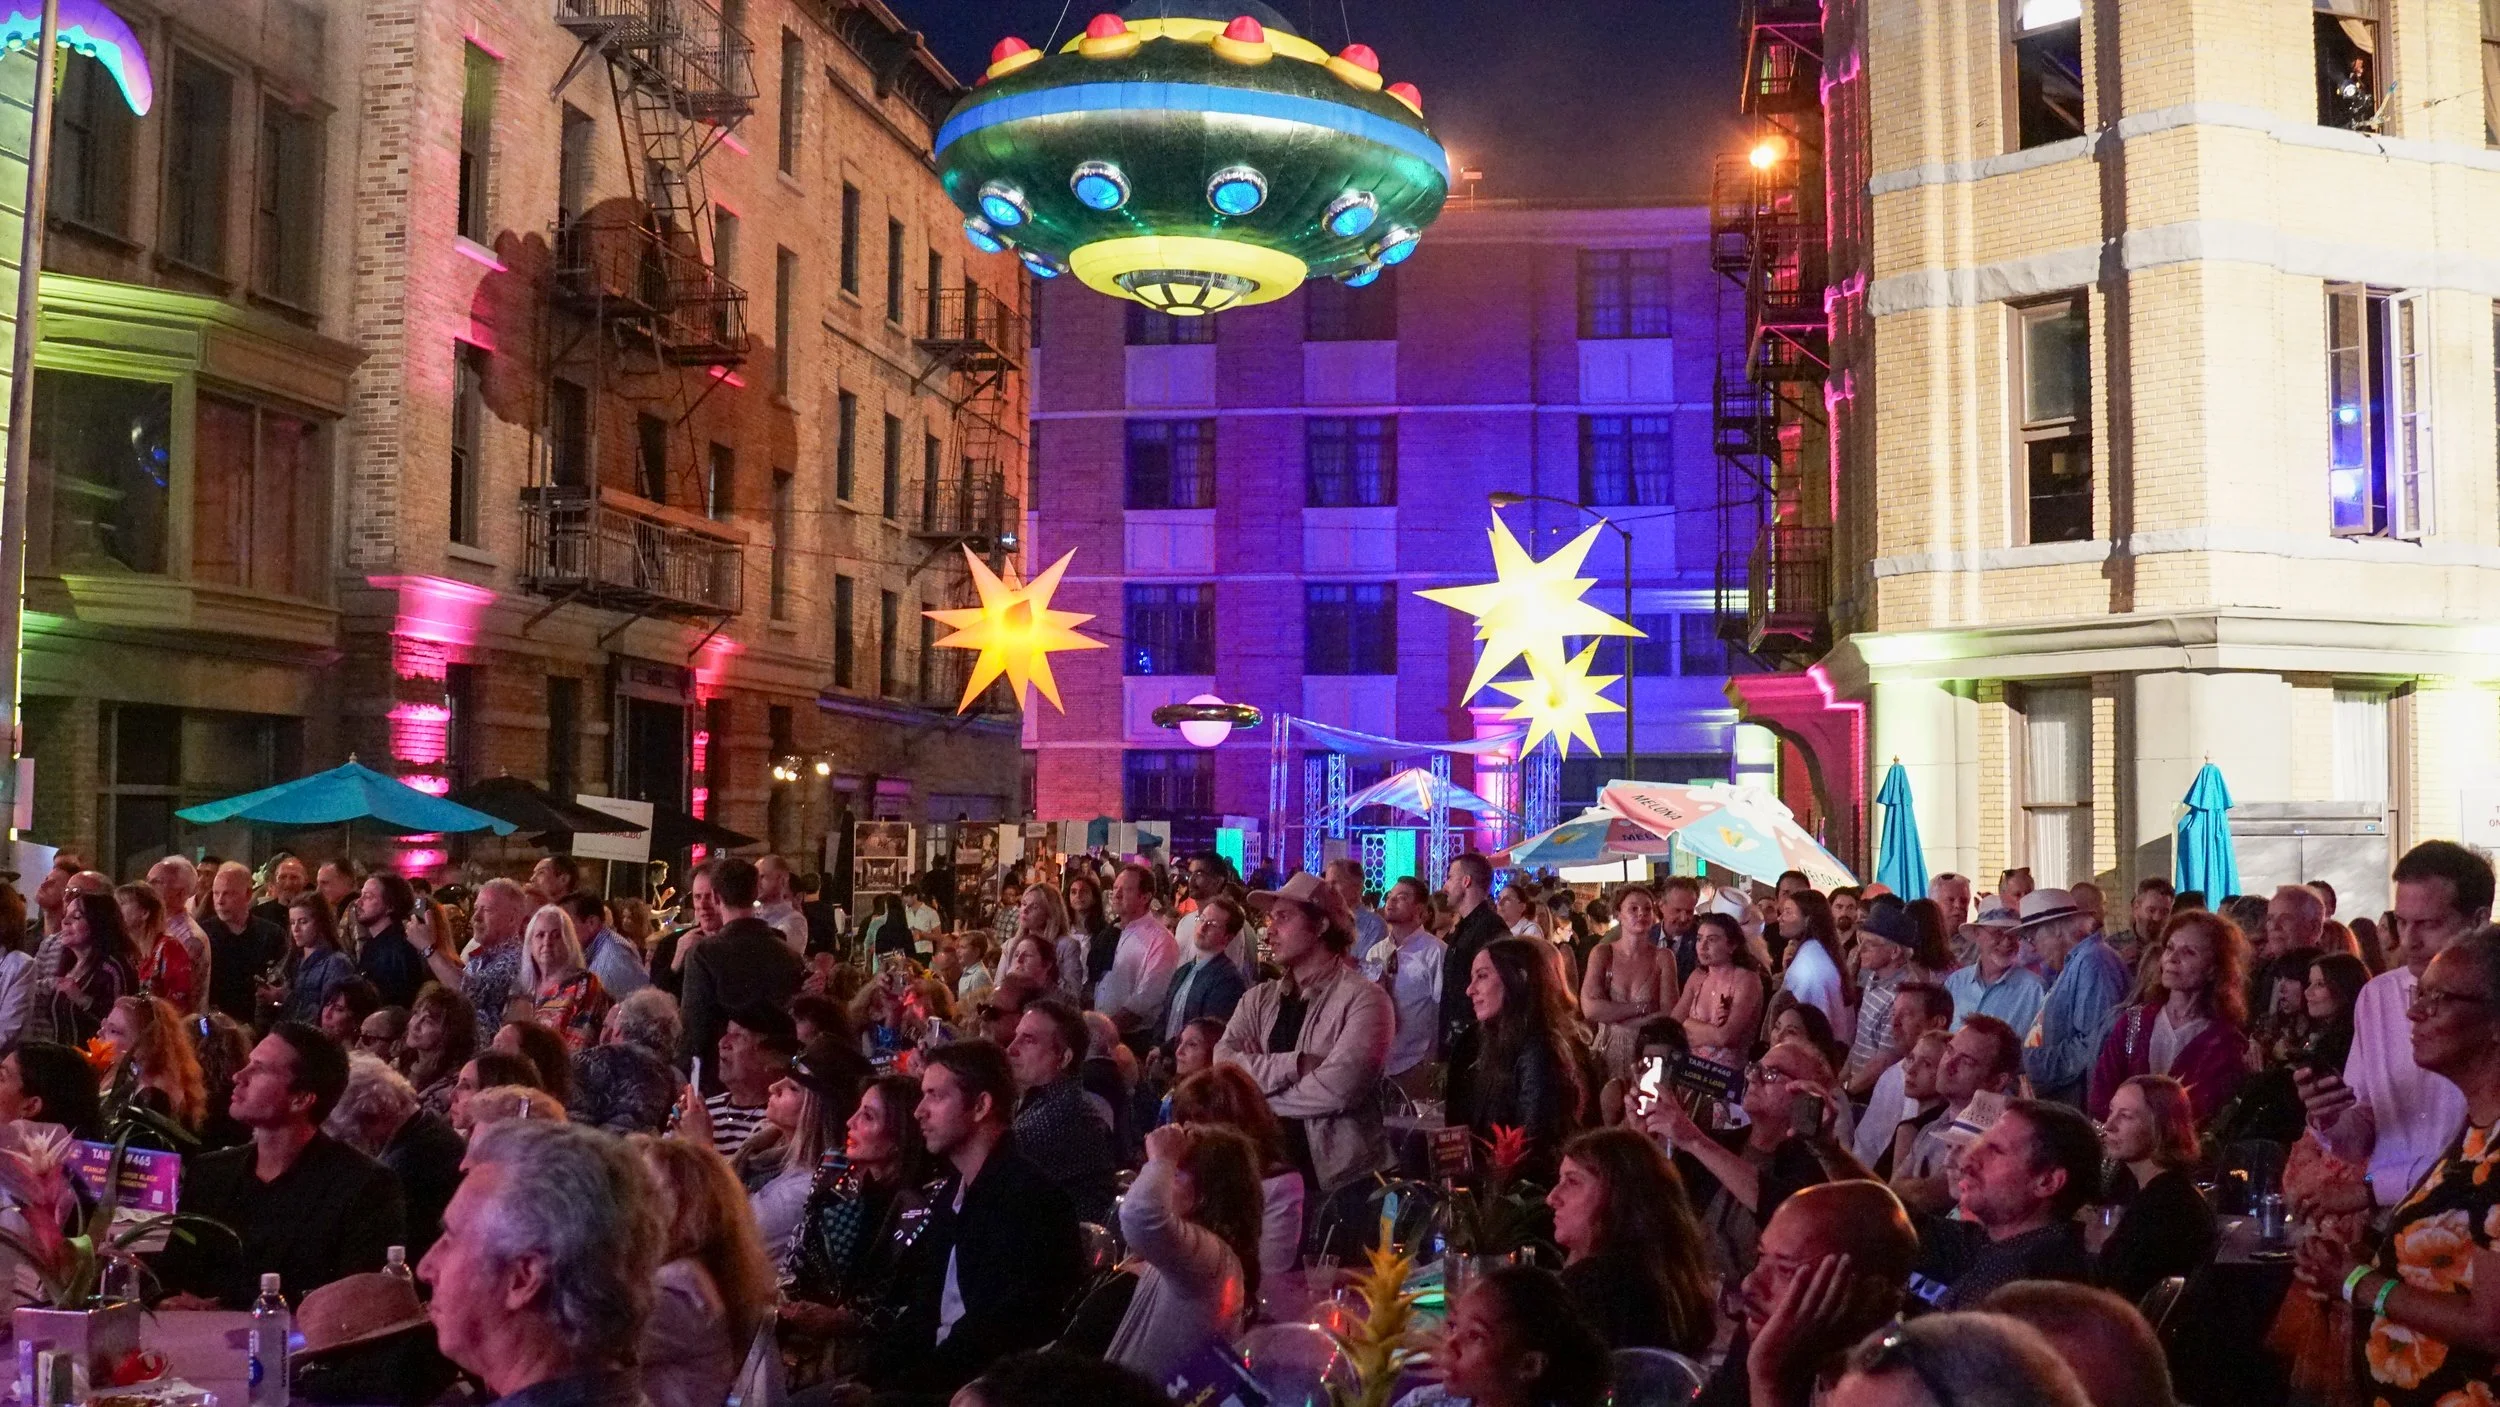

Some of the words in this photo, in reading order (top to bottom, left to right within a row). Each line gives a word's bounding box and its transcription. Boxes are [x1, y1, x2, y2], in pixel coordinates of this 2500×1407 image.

[1632, 794, 1683, 820] MELONA
[1688, 1057, 1710, 1070] TABLE
[92, 1148, 111, 1161] TAB
[125, 1153, 151, 1167] #465
